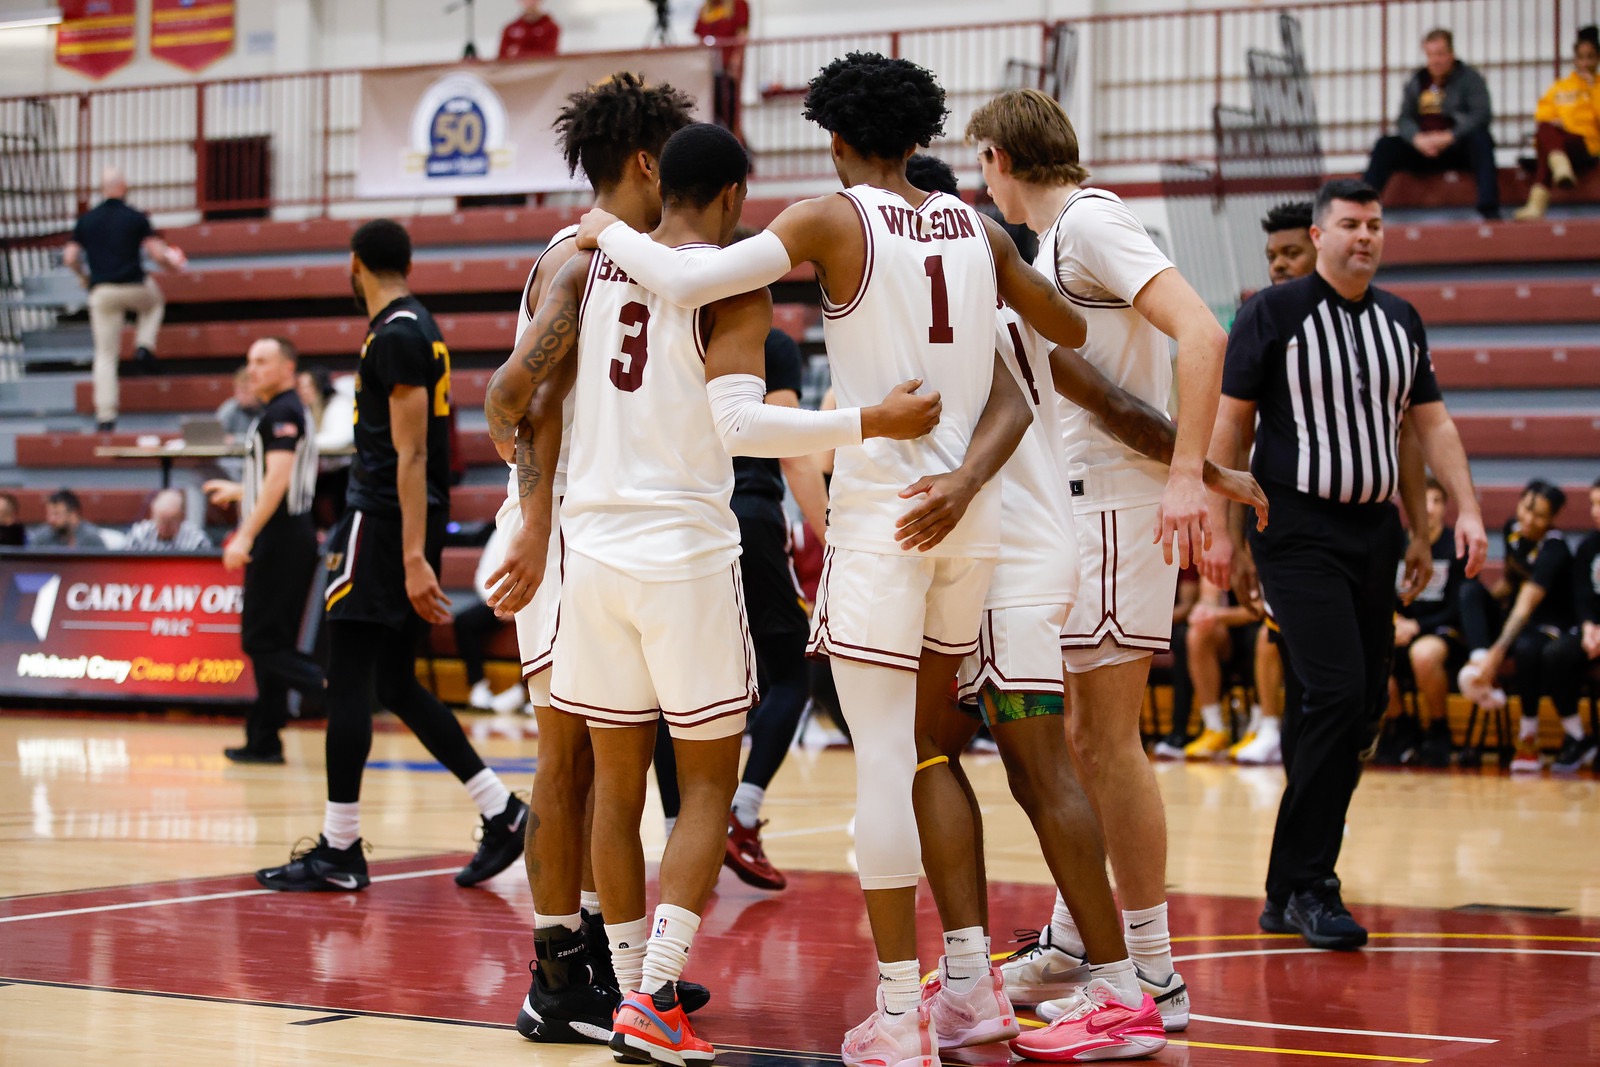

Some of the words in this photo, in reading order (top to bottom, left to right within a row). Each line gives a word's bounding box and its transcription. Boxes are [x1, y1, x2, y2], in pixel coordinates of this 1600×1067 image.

[434, 112, 481, 157] 50
[878, 205, 976, 242] WILSON
[924, 255, 953, 343] 1
[609, 301, 651, 393] 3
[66, 582, 140, 612] CARY
[139, 584, 200, 613] LAW
[87, 655, 133, 684] Cary
[131, 656, 176, 682] Class
[176, 657, 200, 682] of
[198, 659, 245, 684] 2007
